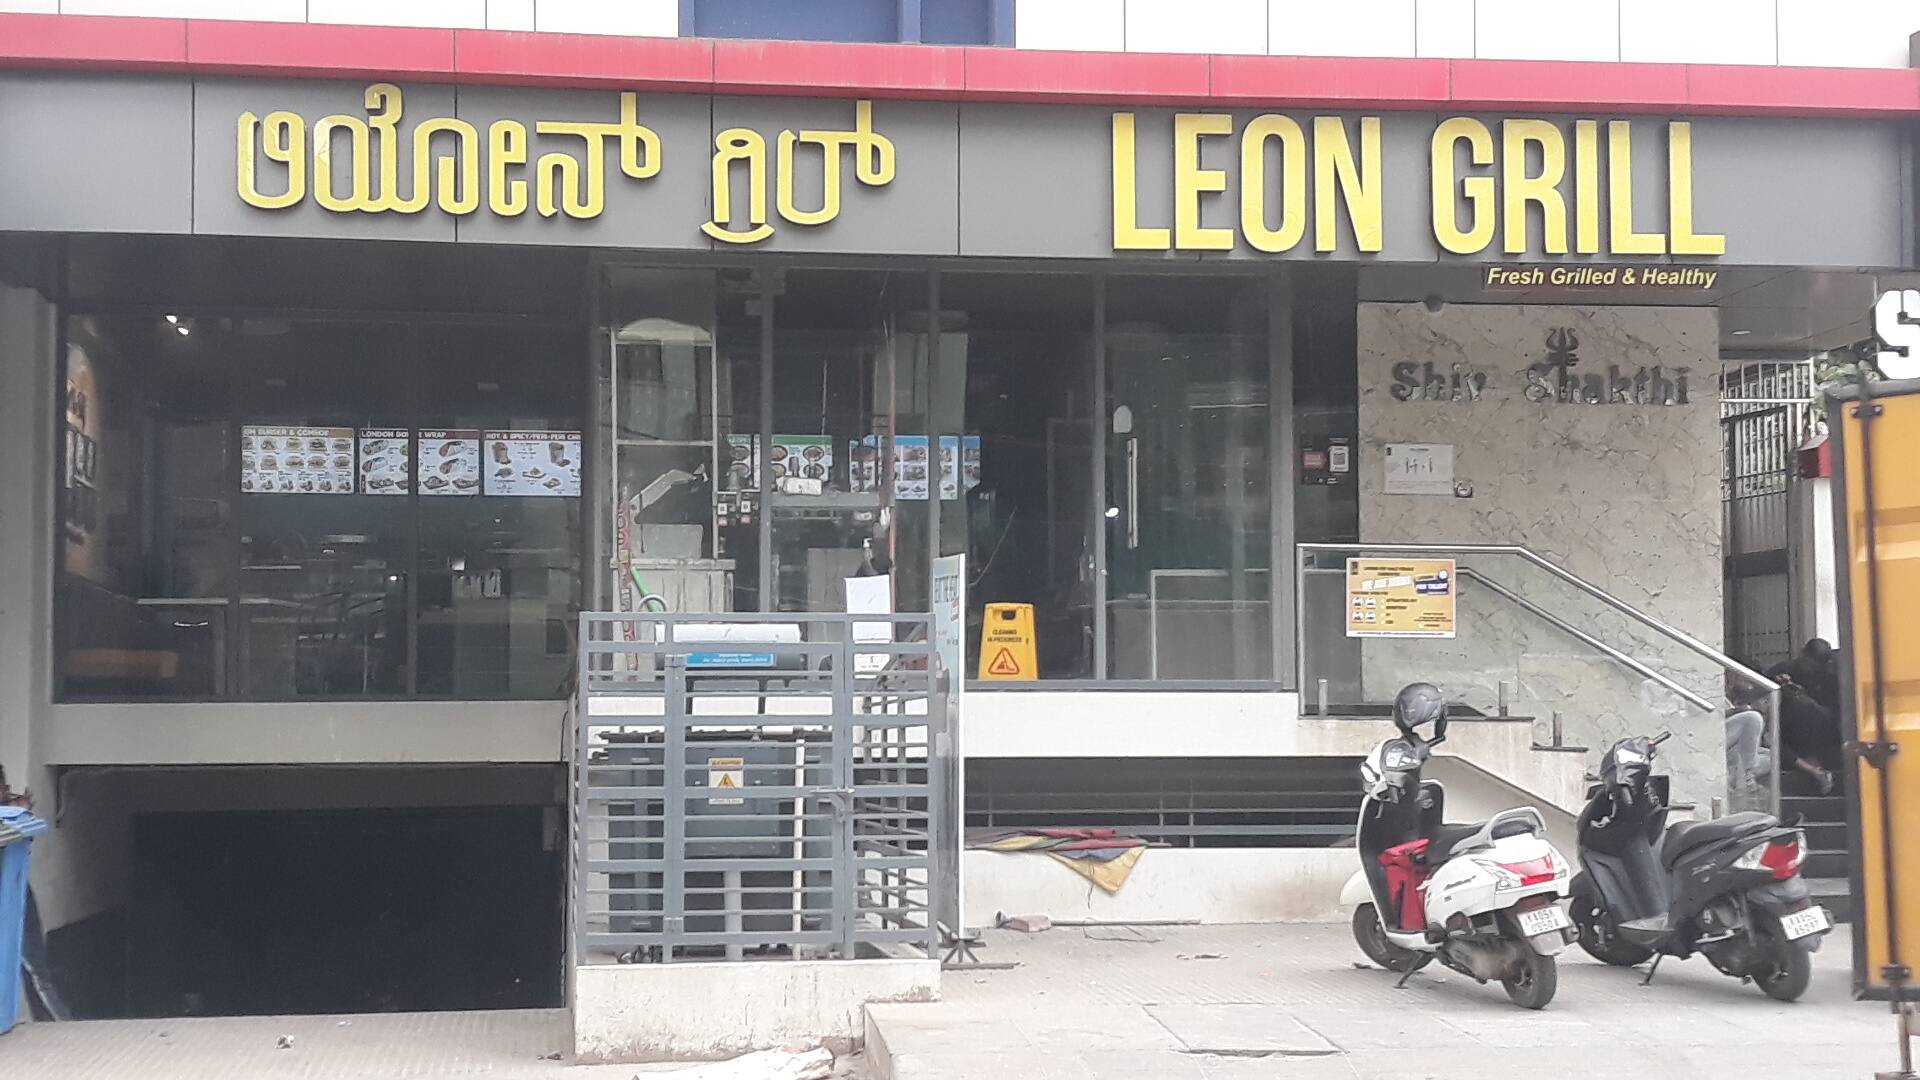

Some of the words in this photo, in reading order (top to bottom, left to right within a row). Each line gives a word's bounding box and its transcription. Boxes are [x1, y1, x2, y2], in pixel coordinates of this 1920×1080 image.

[700, 99, 896, 244] ಗ್ರಿಲ್
[1111, 112, 1383, 253] LEON
[1431, 116, 1726, 256] GRILL
[1487, 267, 1544, 285] Fresh
[1550, 267, 1617, 285] Grilled
[1621, 267, 1636, 285] &
[1641, 269, 1717, 289] Healthy
